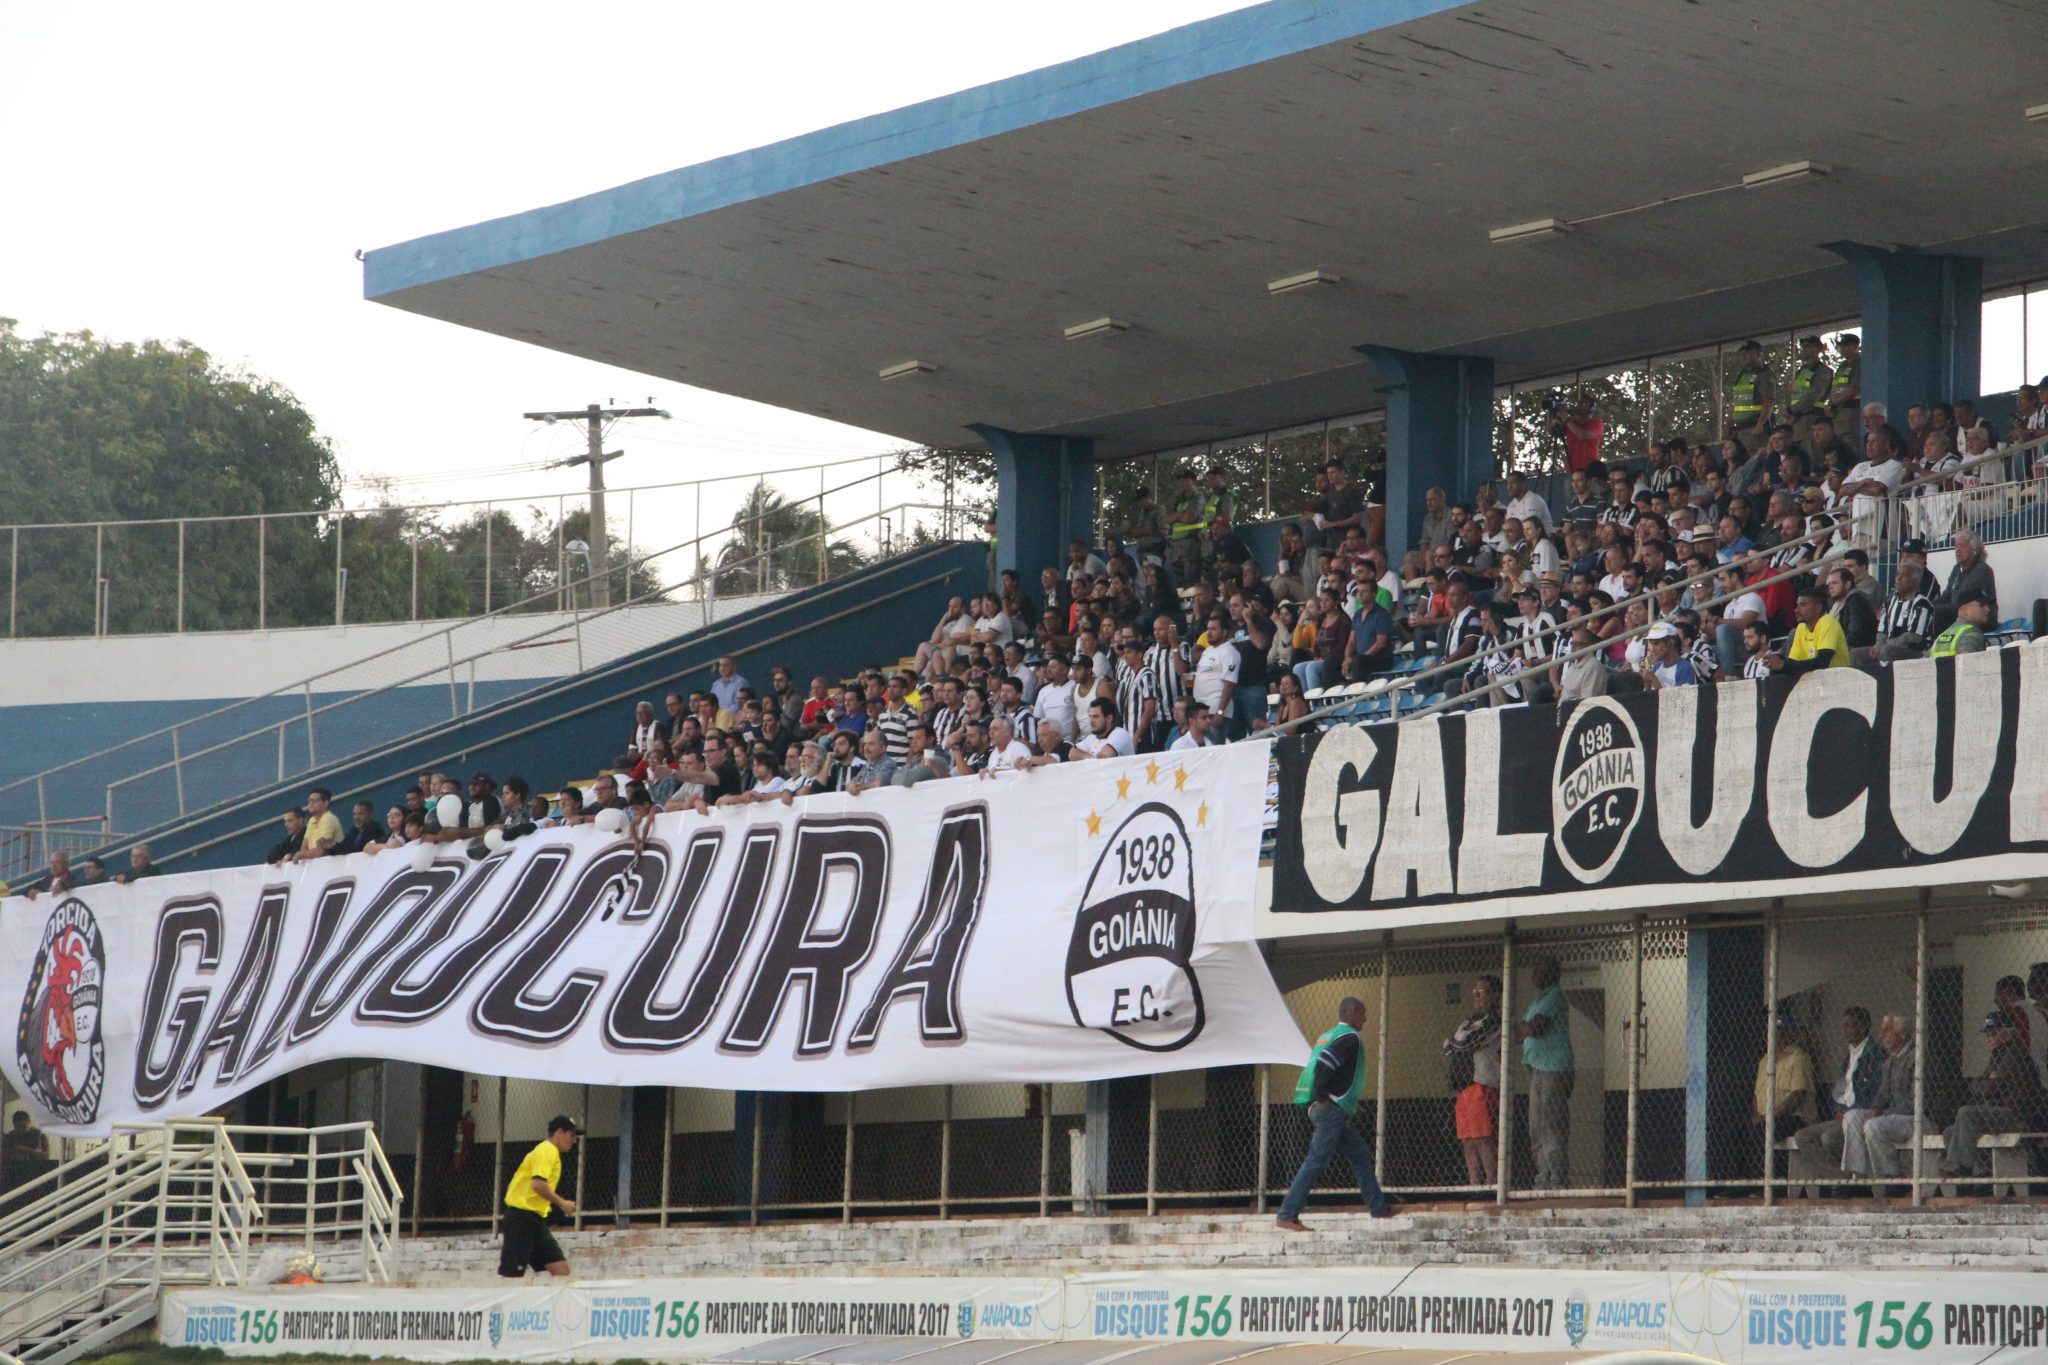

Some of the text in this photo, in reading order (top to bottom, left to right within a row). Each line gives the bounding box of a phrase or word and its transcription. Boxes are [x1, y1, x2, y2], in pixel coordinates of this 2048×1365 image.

[1579, 722, 1612, 758] 1938
[1587, 794, 1621, 833] E.C.
[1116, 832, 1176, 885] 1938
[42, 902, 97, 954] TORCIDA
[1089, 900, 1177, 959] GOIÂNIA
[1111, 985, 1173, 1026] E.C.
[589, 1300, 950, 1340] DISQUE 156 PARTICIPE DA TORCIDA PREMIADA 2017
[1094, 1295, 1554, 1339] DISQUE 156 PARTICIPE DA TORCIDA PREMIADA 2017
[1749, 1294, 1847, 1307] FALE COM A PREFEITURA
[184, 1310, 483, 1344] DISQUE 156 PARTICIPE DA TORCIDA PREMIADA 2017
[1748, 1300, 2048, 1350] DISQUE 156 PARTICIP
